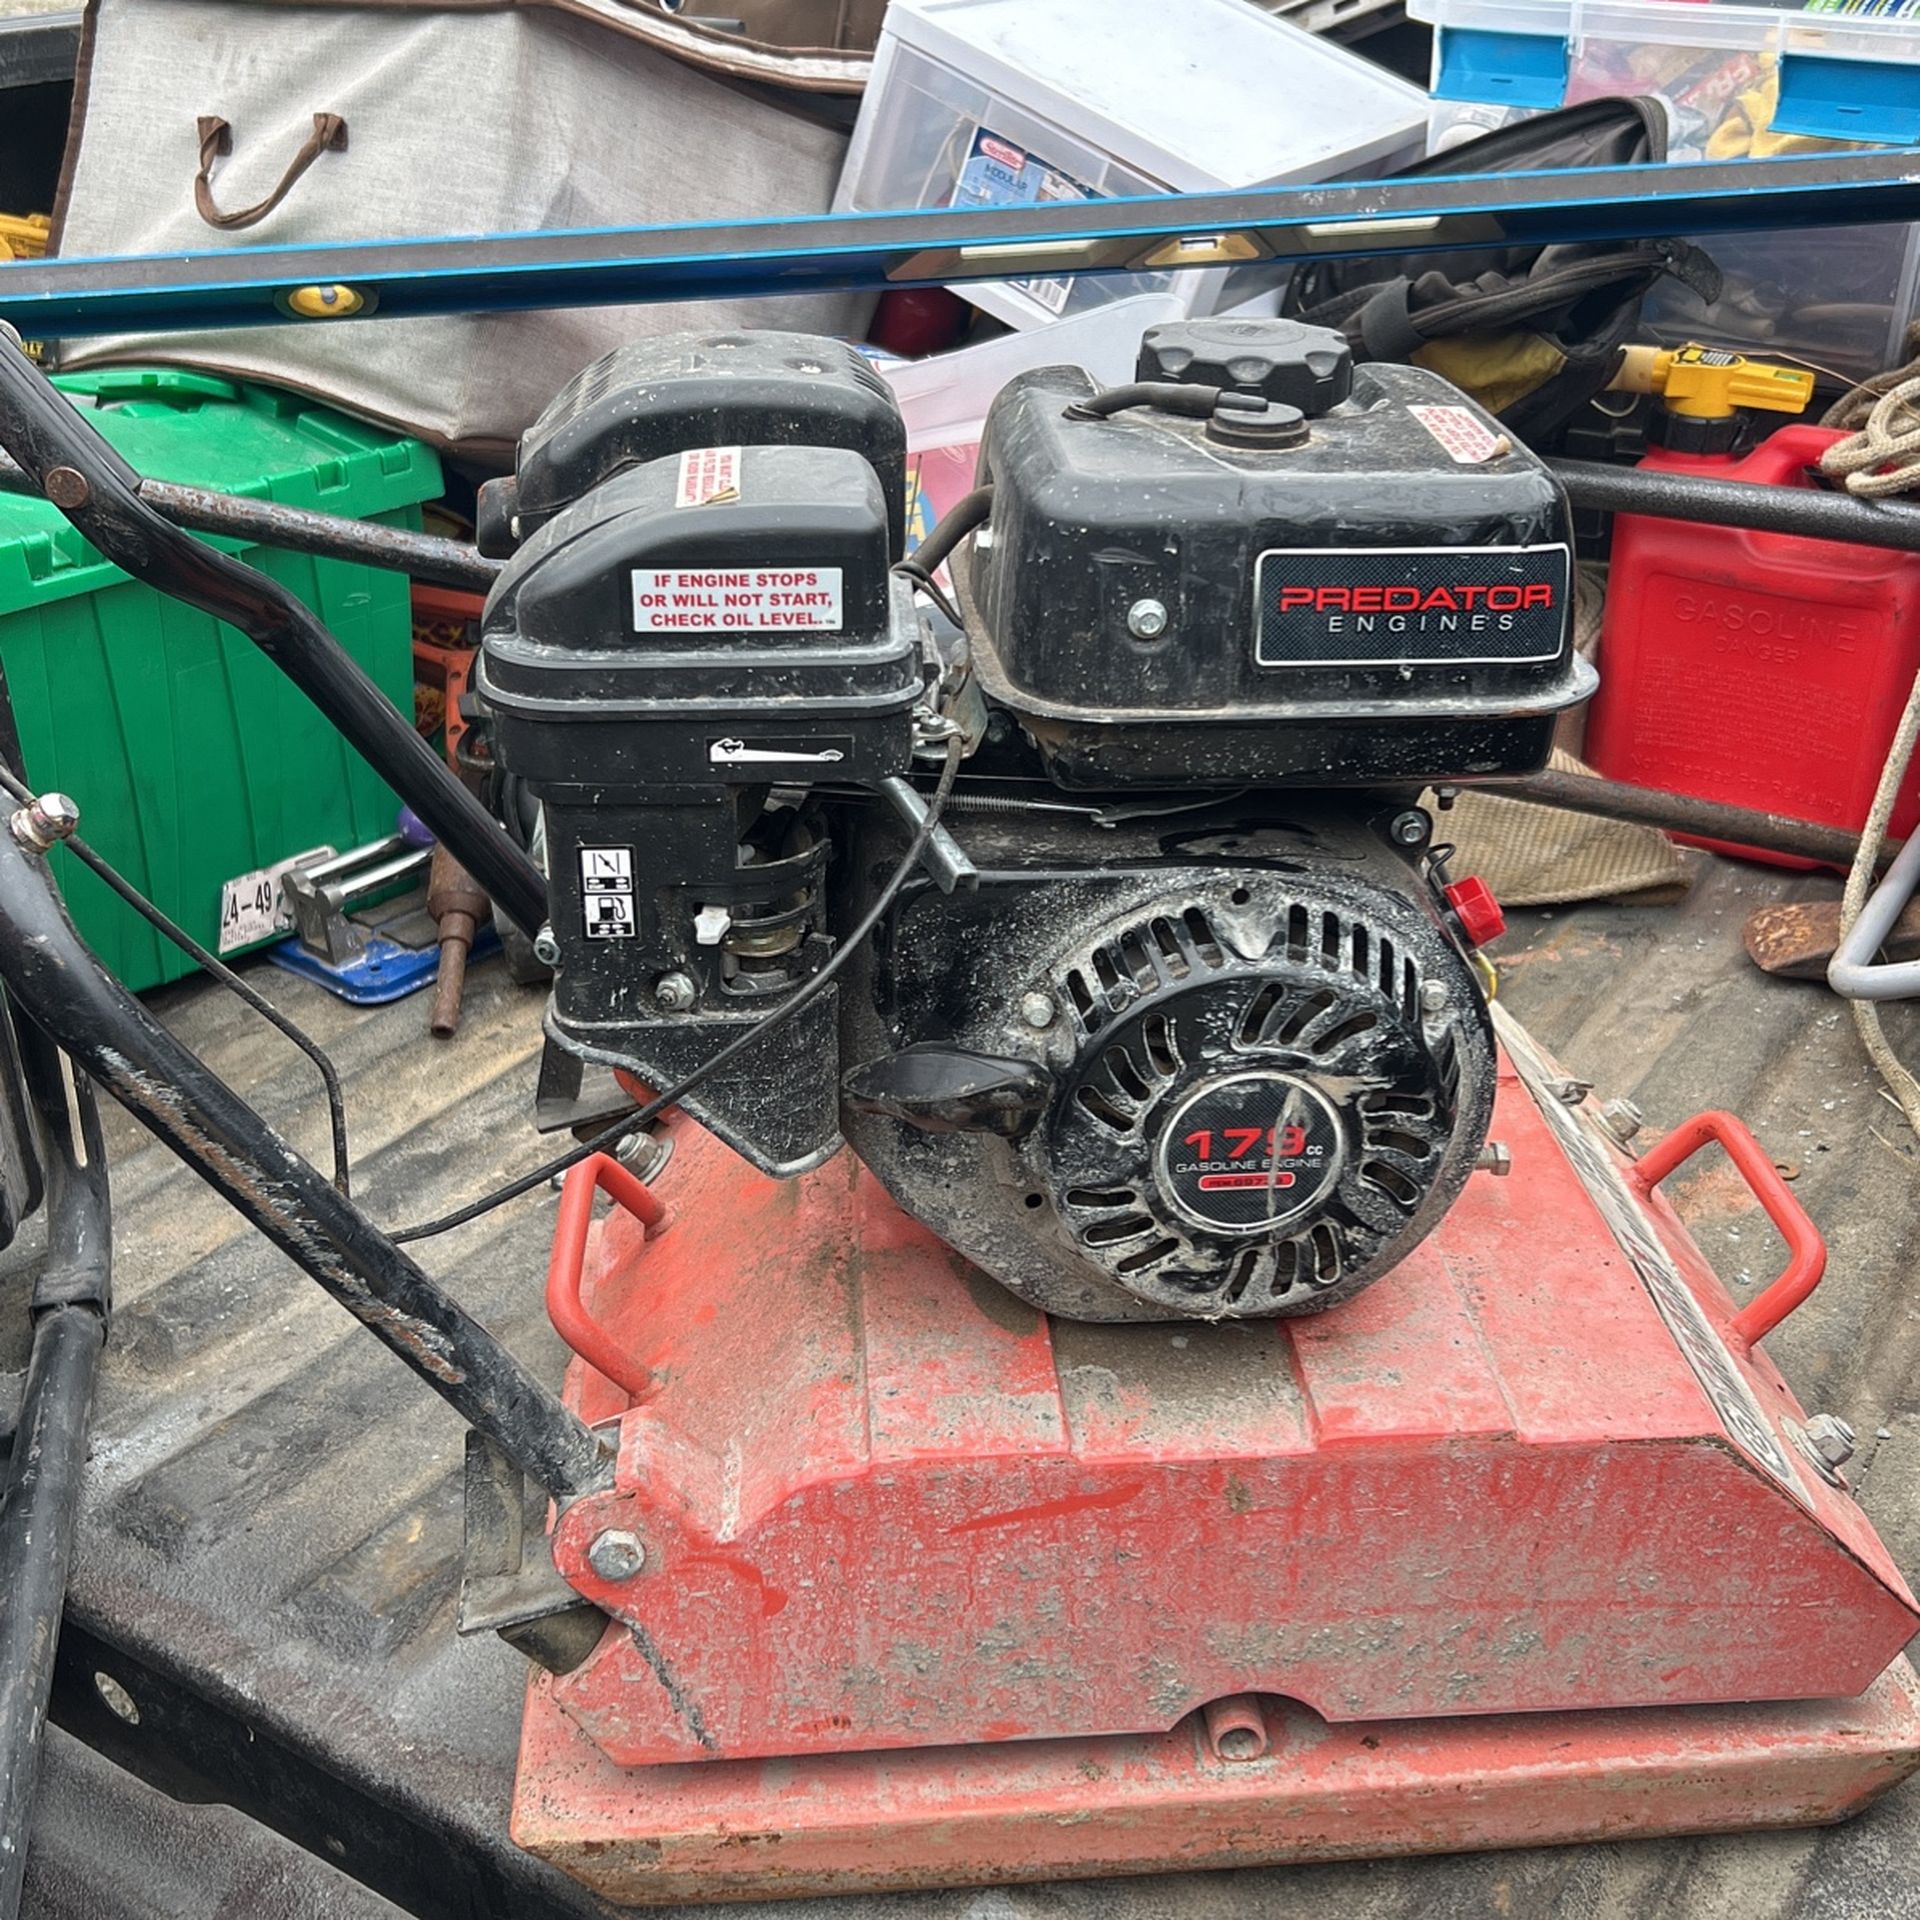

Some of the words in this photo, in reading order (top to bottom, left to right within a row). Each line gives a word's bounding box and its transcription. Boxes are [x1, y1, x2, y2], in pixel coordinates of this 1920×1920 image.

[654, 575, 671, 587] IF
[678, 574, 750, 587] ENGINE
[756, 573, 817, 587] STOPS
[640, 594, 667, 607] OR
[673, 594, 718, 607] WILL
[724, 594, 764, 607] NOT
[770, 593, 833, 607] START,
[1280, 584, 1552, 612] PREDATOR
[651, 614, 717, 626] CHECK
[723, 613, 754, 626] OIL
[760, 613, 823, 626] LEVEL.
[1328, 614, 1515, 633] ENGINES
[1672, 595, 1860, 654] GASOLINE
[1713, 635, 1803, 664] DANGER
[1175, 1160, 1257, 1173] GASOLINE
[1261, 1158, 1322, 1169] ENGINE
